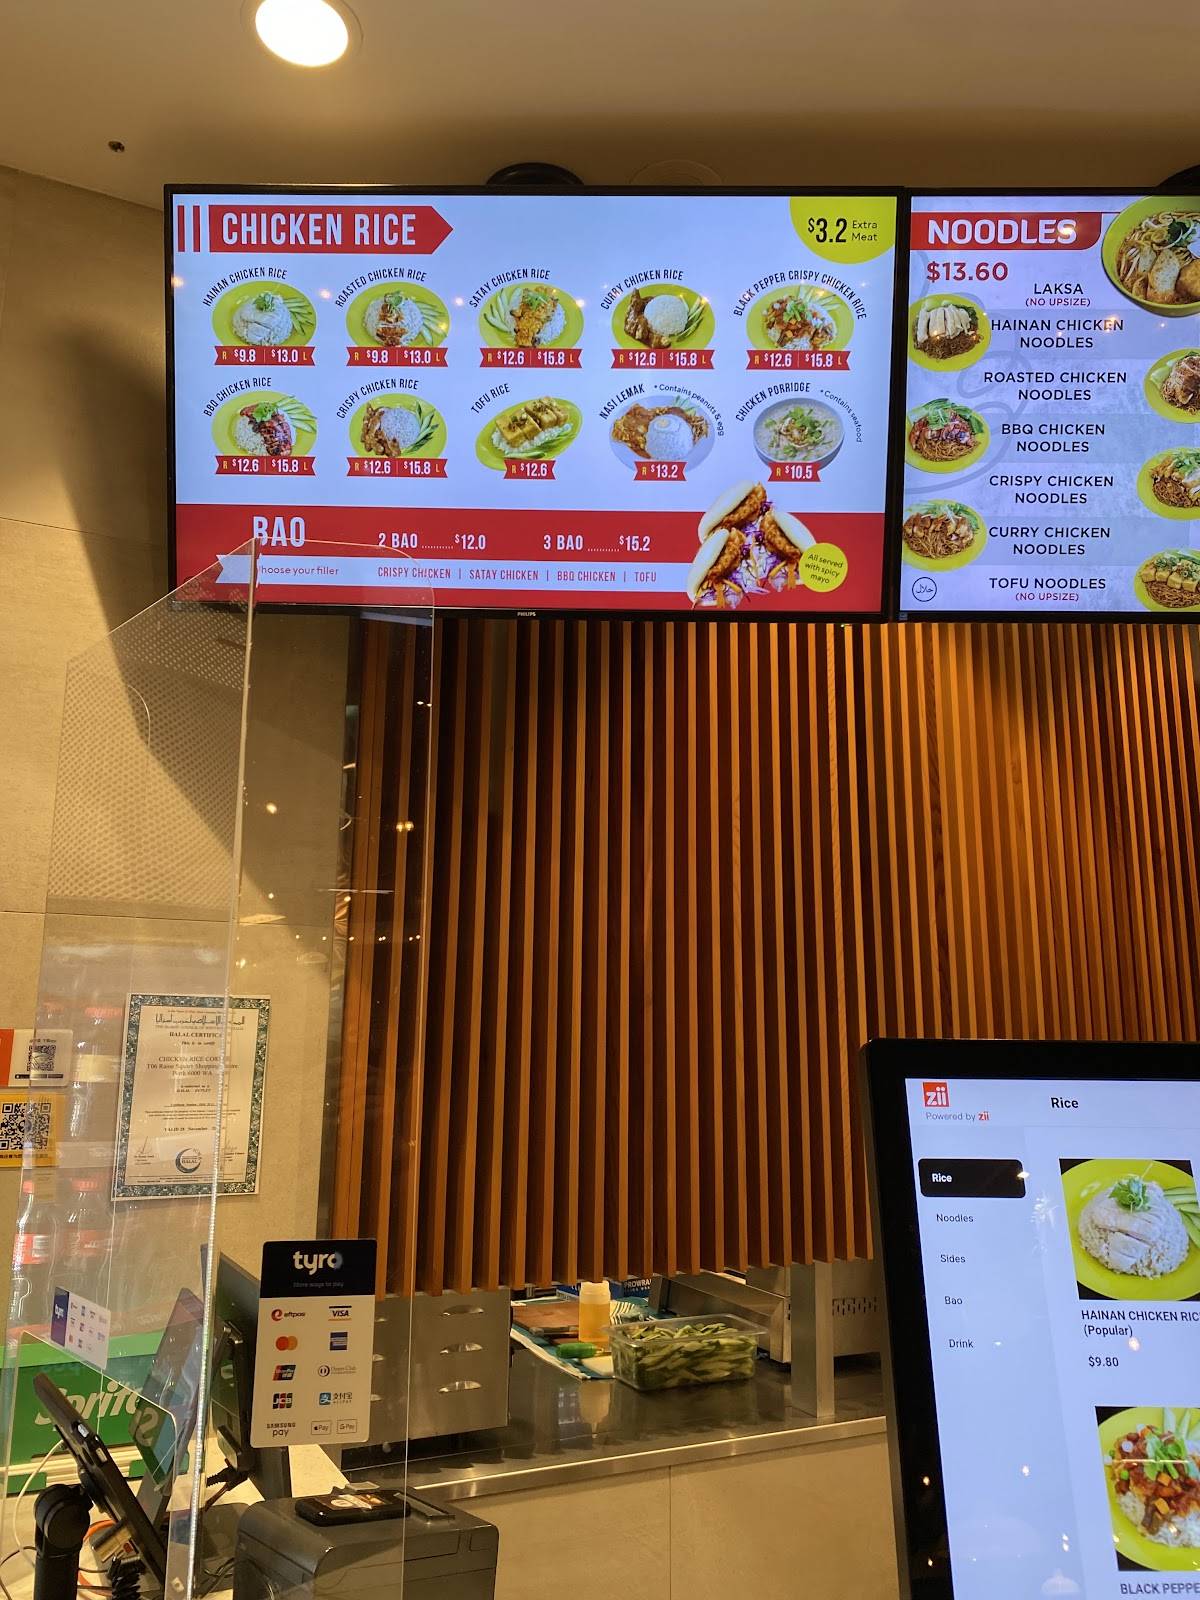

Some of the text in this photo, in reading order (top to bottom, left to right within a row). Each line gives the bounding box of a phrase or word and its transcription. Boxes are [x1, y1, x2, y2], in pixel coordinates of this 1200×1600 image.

[222, 212, 417, 245] CHICKEN RICE
[808, 217, 847, 243] $3.2
[852, 220, 878, 229] Extra
[852, 233, 878, 241] Meat
[928, 219, 1077, 244] NOODLES
[926, 261, 1009, 283] $13.60
[203, 267, 287, 306] HAINAN CHICKEN RICE
[335, 268, 427, 307] ROASTED CHICKEN RICE
[469, 269, 550, 308] SATAY CHICKEN RICE
[600, 269, 684, 310] CURRY CHICKEN RICE
[1033, 283, 1084, 295] LAKSA
[734, 270, 867, 320] BLACK PEPPER CRISPY CHICKEN RICE
[1025, 298, 1091, 307] (NO UPSIZE)
[991, 320, 1124, 332] HAINAN CHICKEN
[1020, 337, 1094, 348] NOODLES
[222, 349, 307, 363] R $9.8 $13.0 L
[355, 350, 440, 363] R $9.8 $13.0 L
[488, 351, 574, 365] R $12.6 $15.8 L
[620, 352, 706, 366] R $12.6 $15.8 L
[755, 353, 842, 367] R $12.6 $15.8 L
[984, 372, 1127, 384] ROASTED CHICKEN
[204, 377, 271, 416] BBQ CHICKEN RICE
[336, 379, 419, 419] CRISPY CHICKEN RICE
[471, 383, 510, 414] TOFU RICE
[599, 383, 644, 419] NASI LEMAK
[659, 384, 691, 396] Contains
[691, 393, 716, 414] peanuts
[1018, 389, 1091, 401] NOODLES
[736, 382, 811, 421] CHICKEN PORRIDGE
[824, 391, 862, 443] Contains seafood
[1001, 424, 1106, 437] BBQ CHICKEN
[1016, 441, 1089, 452] NOODLES
[223, 459, 308, 472] R $12.6 $15.8 L
[355, 460, 440, 474] R $12.6 $15.8 L
[512, 463, 547, 476] R $12.6
[642, 464, 678, 478] R $13.2
[777, 465, 812, 479] R $10.5
[989, 475, 1114, 487] CRISPY CHICKEN
[1015, 493, 1087, 504] NOODLES
[253, 516, 306, 547] BAO
[989, 527, 1110, 539] CURRY CHICKEN
[378, 532, 486, 550] 2 BAO $12.0
[543, 535, 651, 552] 3 BAO $15.2
[1013, 544, 1085, 555] NOODLES
[819, 557, 843, 568] served
[261, 566, 339, 575] hoose your filler
[378, 566, 451, 579] CRISPY CHICKEN
[469, 569, 539, 581] SATAY CHICKEN
[805, 563, 839, 577] with spicy
[557, 571, 616, 582] BBQ CHICKEN
[634, 571, 657, 583] TOFU
[811, 574, 829, 583] mayo
[990, 578, 1106, 589] TOFU NOODLES
[1015, 592, 1079, 602] (NO UPSIZE)
[1050, 1097, 1079, 1109] Rice
[926, 1111, 990, 1122] Powered by zii
[932, 1173, 952, 1183] Rice
[936, 1213, 974, 1223] Noodles
[292, 1250, 343, 1276] tyro
[940, 1254, 966, 1264] Sides
[624, 1279, 652, 1288] PROWRA
[944, 1296, 963, 1305] Bao
[1081, 1310, 1200, 1322] HAINAN CHICKEN RIC
[1084, 1325, 1133, 1337] (Popular)
[949, 1339, 974, 1348] Drink
[1088, 1356, 1119, 1368] $9.80
[272, 1428, 289, 1437] pay
[1120, 1583, 1200, 1594] BLACK PEPPE
